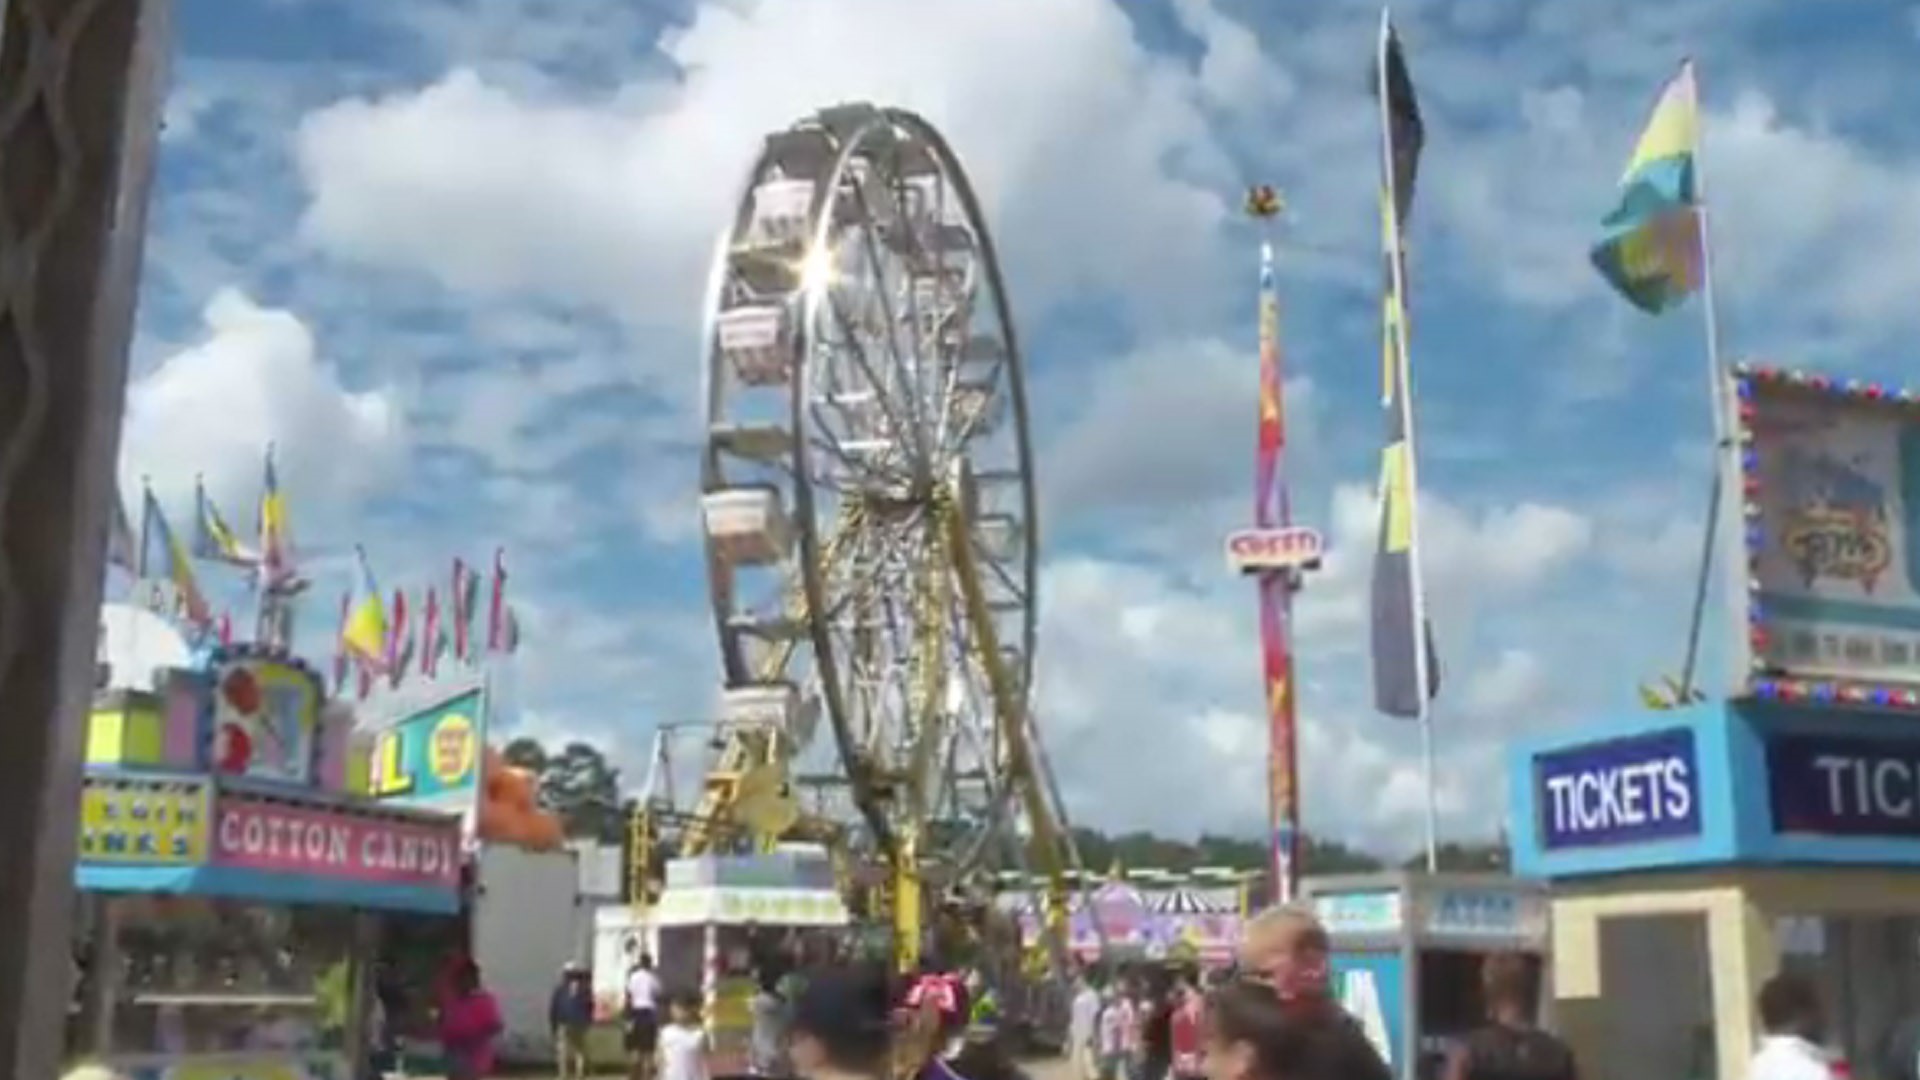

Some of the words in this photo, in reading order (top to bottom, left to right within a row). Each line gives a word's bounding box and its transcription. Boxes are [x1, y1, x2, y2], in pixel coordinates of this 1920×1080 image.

[1547, 757, 1690, 832] TICKETS
[1813, 755, 1920, 818] TIC
[220, 811, 349, 865] COTTON
